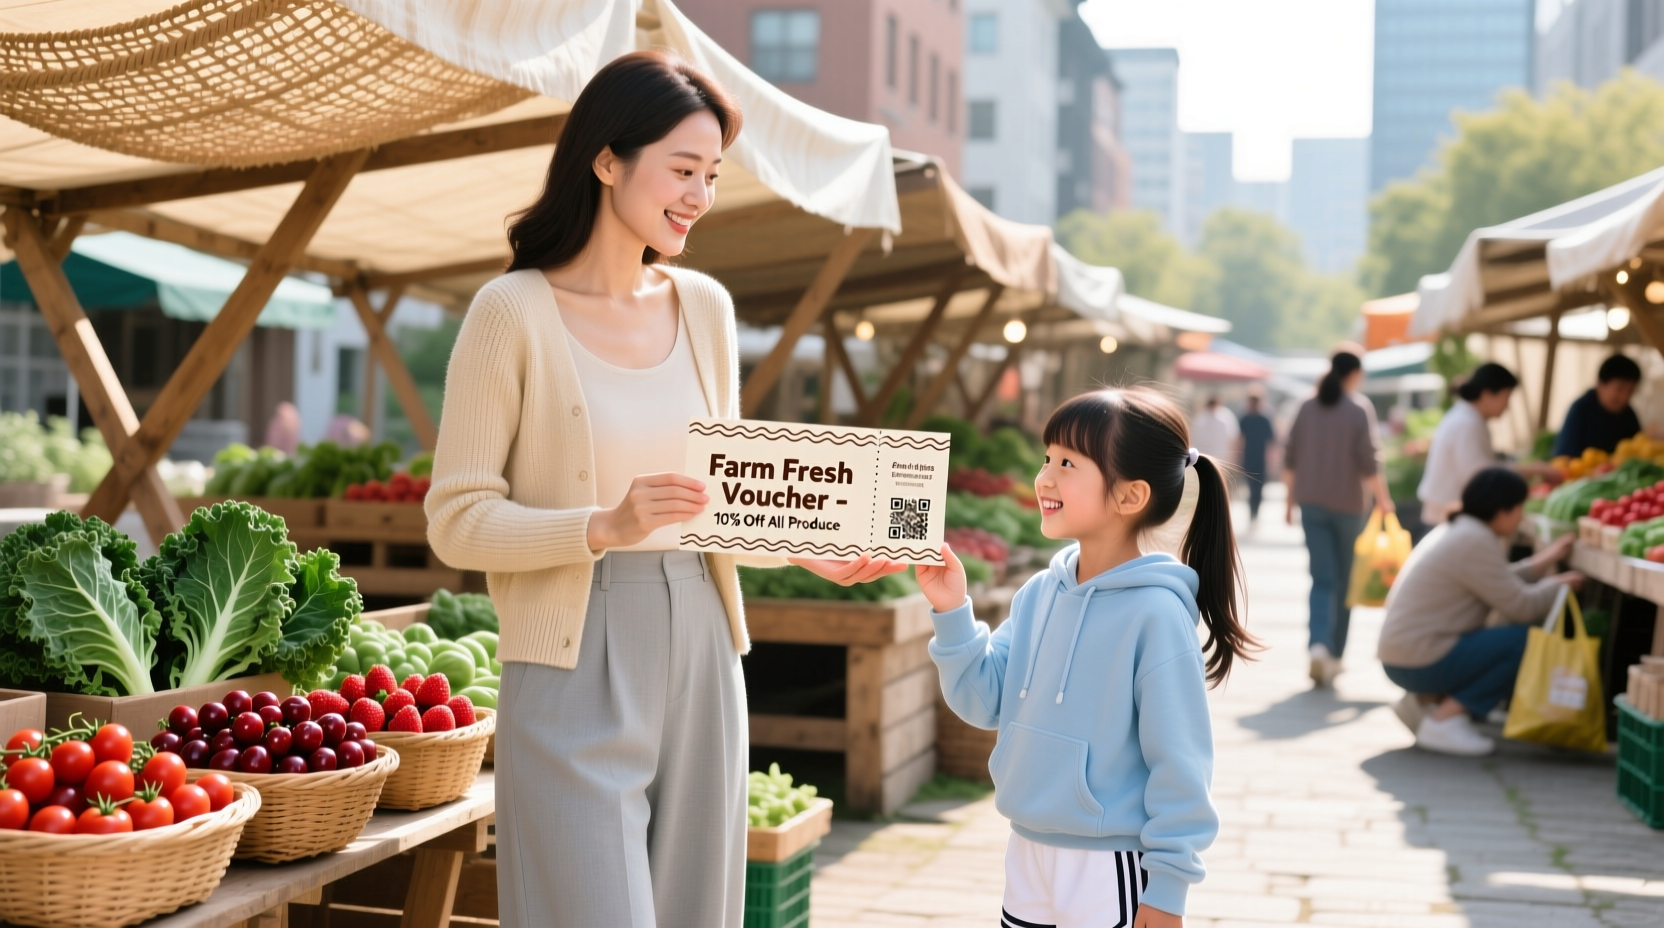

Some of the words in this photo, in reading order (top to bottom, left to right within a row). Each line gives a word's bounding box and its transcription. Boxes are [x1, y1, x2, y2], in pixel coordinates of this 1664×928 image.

[709, 453, 775, 480] Farm
[782, 458, 853, 485] Fresh
[721, 481, 830, 510] Voucher
[713, 512, 741, 527] 10%
[743, 513, 766, 528] Off
[768, 515, 784, 529] All
[788, 516, 841, 531] Produce
